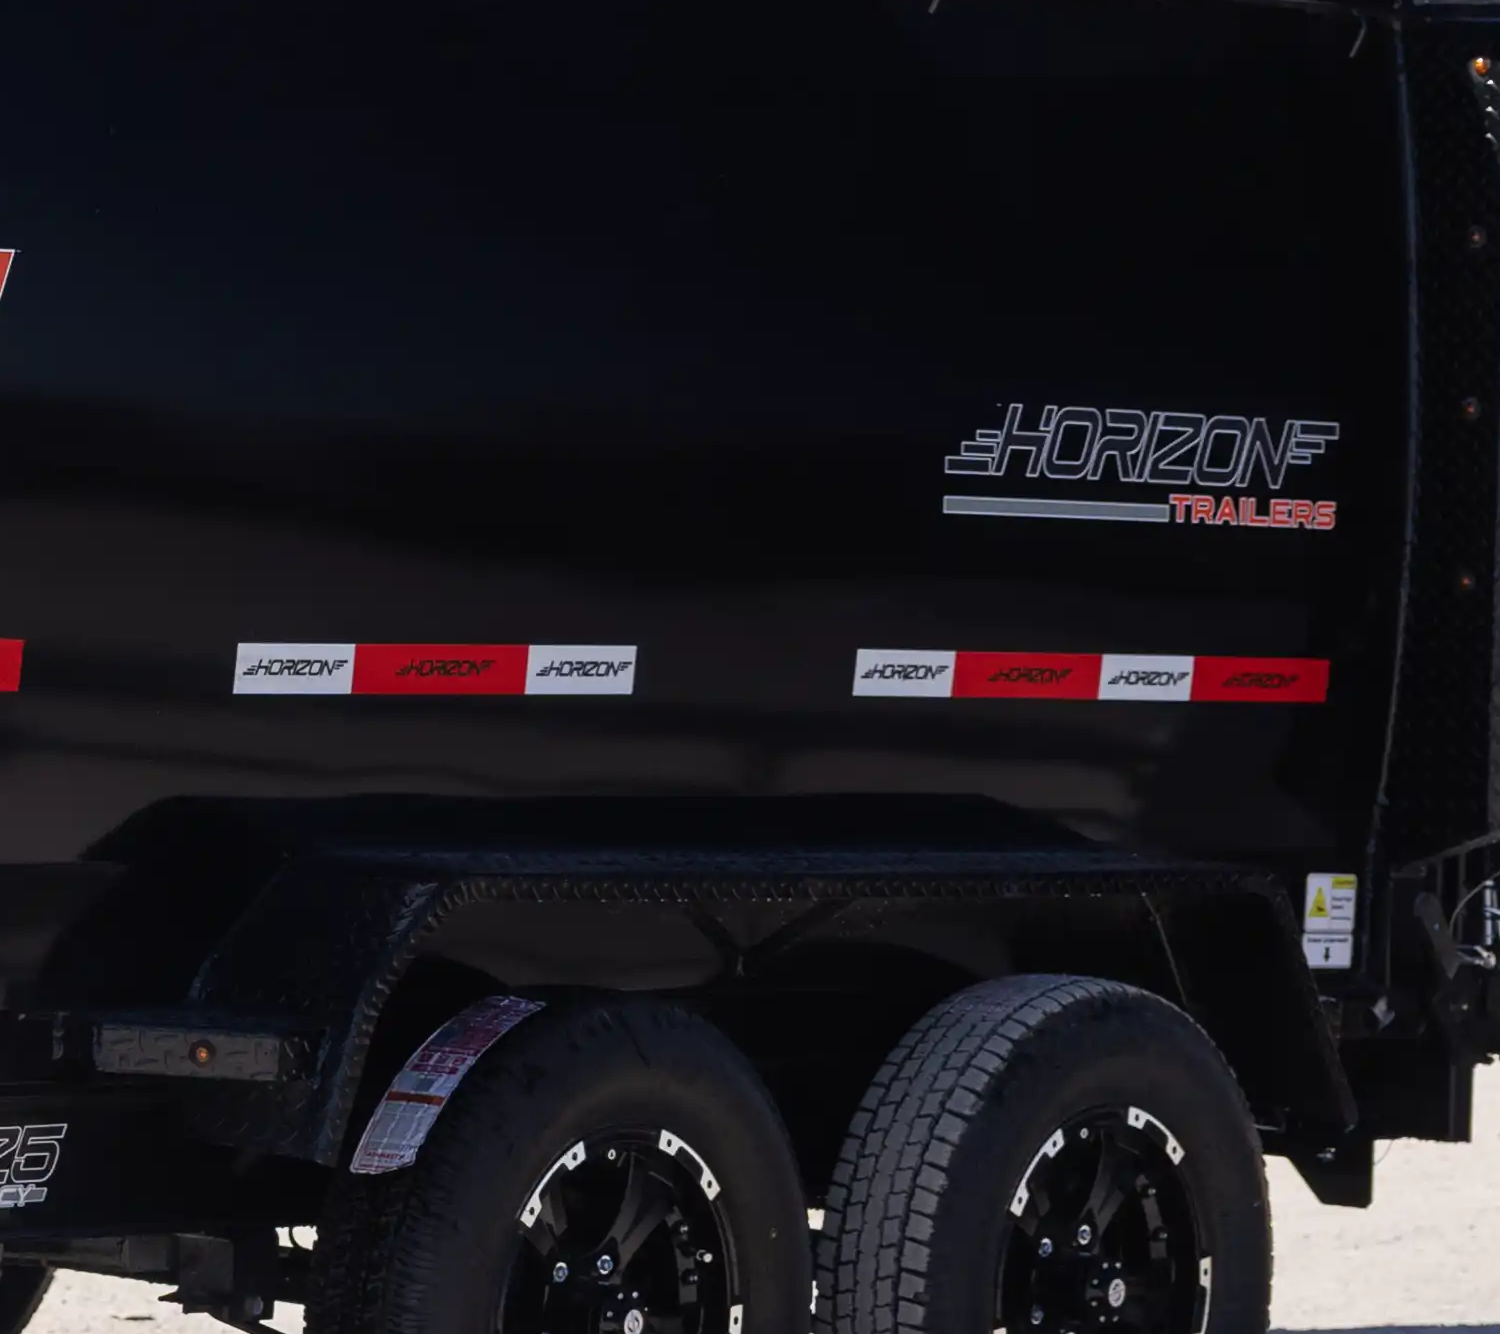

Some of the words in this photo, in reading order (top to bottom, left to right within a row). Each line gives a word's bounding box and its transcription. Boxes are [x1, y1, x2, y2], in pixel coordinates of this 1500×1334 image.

[992, 403, 1296, 489] HORIZON
[1169, 494, 1337, 529] TRAILERS
[253, 659, 337, 676] HORIZON
[405, 660, 487, 677] HORIZON
[545, 661, 624, 677] HORIZON
[869, 663, 939, 680] HORIZON
[997, 667, 1065, 683] HORIZON
[1116, 670, 1182, 686] HORIZON
[1230, 673, 1293, 688] HORIZON
